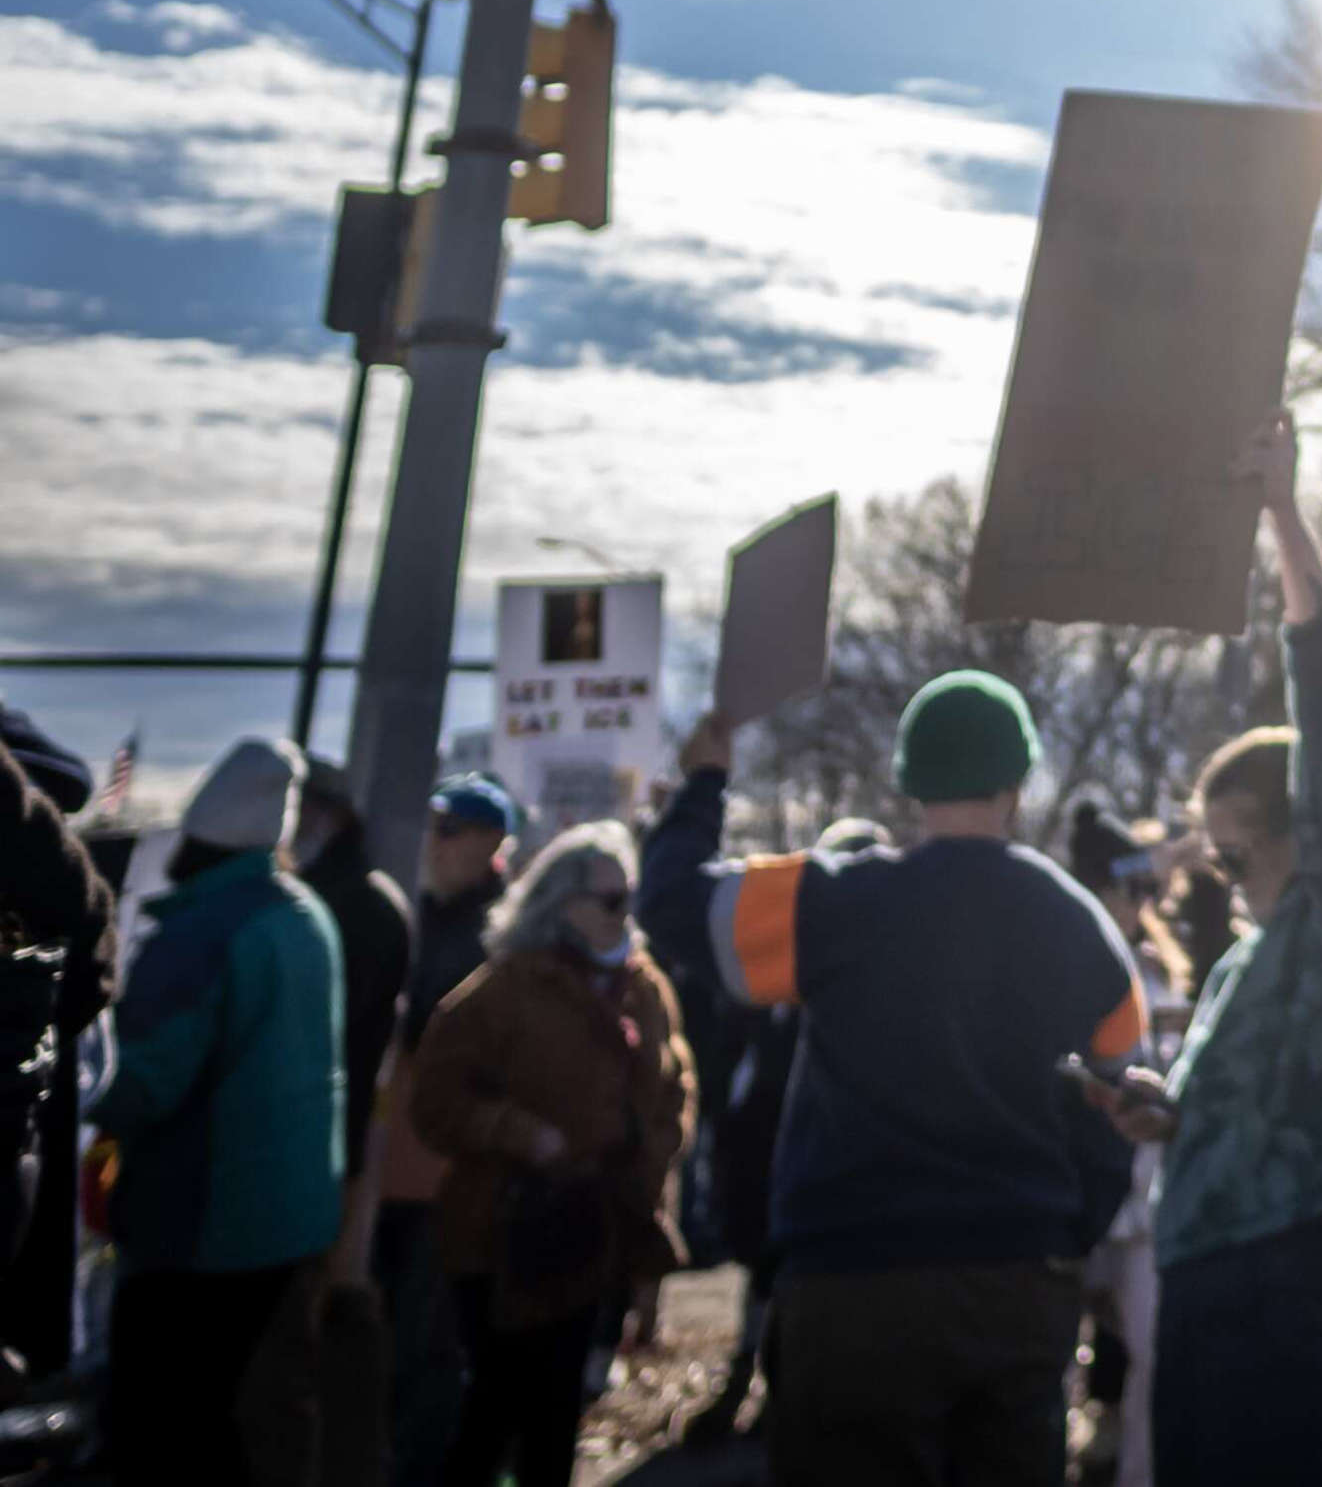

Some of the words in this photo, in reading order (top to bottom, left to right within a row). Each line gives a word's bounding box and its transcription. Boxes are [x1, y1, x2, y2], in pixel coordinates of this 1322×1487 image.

[507, 680, 553, 703] LET
[576, 676, 650, 700] THEM
[506, 711, 560, 738] EAT
